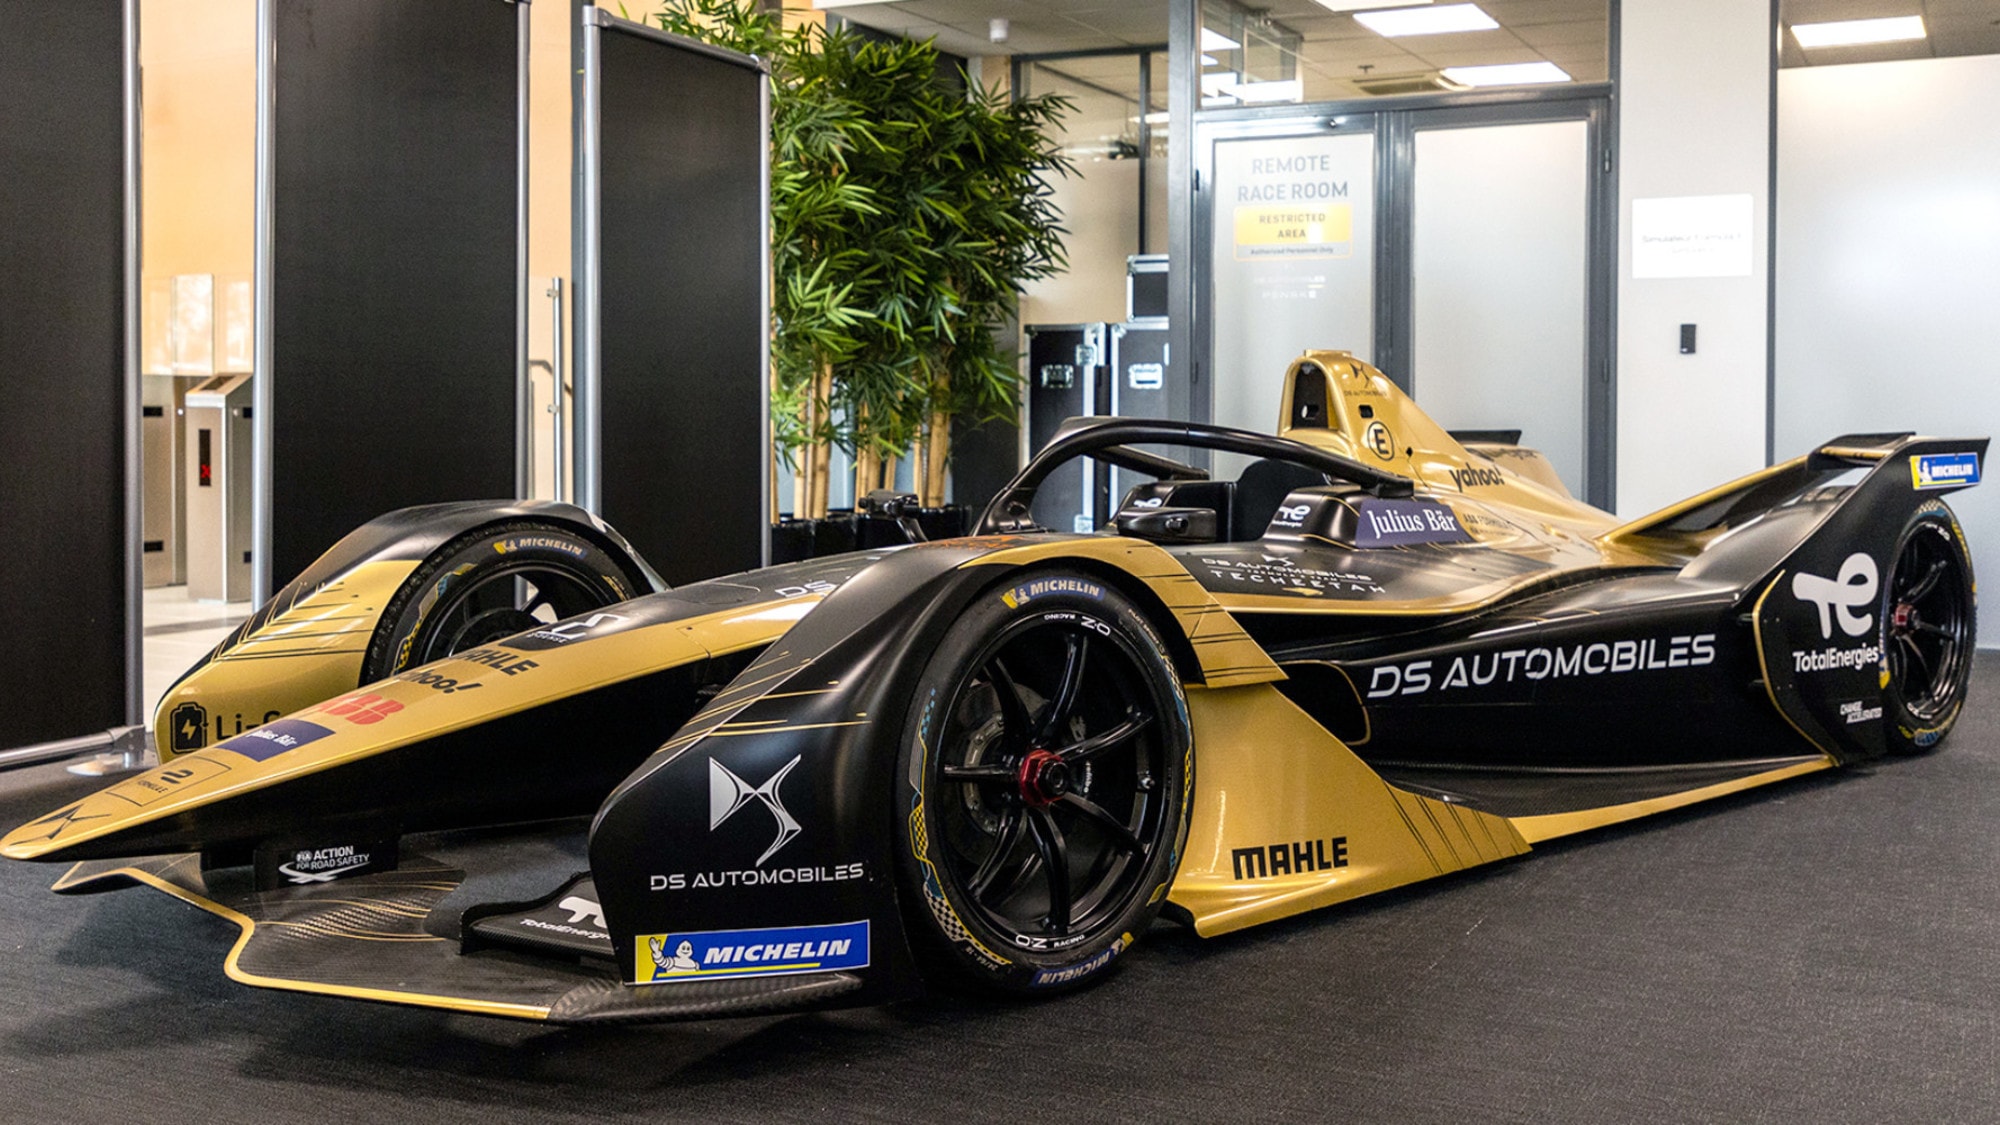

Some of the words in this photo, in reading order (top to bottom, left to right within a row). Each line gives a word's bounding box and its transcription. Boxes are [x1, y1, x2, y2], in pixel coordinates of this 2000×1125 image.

[1252, 155, 1331, 174] REMOTE
[1237, 184, 1287, 202] RACE
[1291, 181, 1349, 199] ROOM
[1259, 213, 1326, 224] RESTRICTED
[1277, 229, 1307, 239] AREA
[1449, 462, 1505, 494] yahoo!
[1931, 463, 1973, 478] MICHELIN
[1367, 509, 1424, 540] Julius
[1424, 508, 1458, 532] Bär
[519, 538, 583, 555] MICHELIN
[1201, 557, 1231, 567] DS
[1235, 561, 1372, 582] AUTOMOBILES
[1030, 580, 1100, 598] MICHELIN
[1210, 570, 1386, 594] TECHEETAH
[1367, 661, 1432, 698] DS
[1440, 634, 1716, 690] AUTOMOBILES
[1793, 643, 1880, 673] TotalEnergies
[311, 859, 336, 870] ROAD
[336, 853, 370, 867] SAFETY
[313, 845, 354, 860] ACTION
[1232, 837, 1348, 880] MAHLE
[651, 874, 686, 891] DS
[692, 863, 864, 888] AUTOMOBILES
[704, 939, 852, 965] MICHELIN
[1053, 934, 1086, 948] RACING
[1038, 950, 1110, 984] MICHELIN
